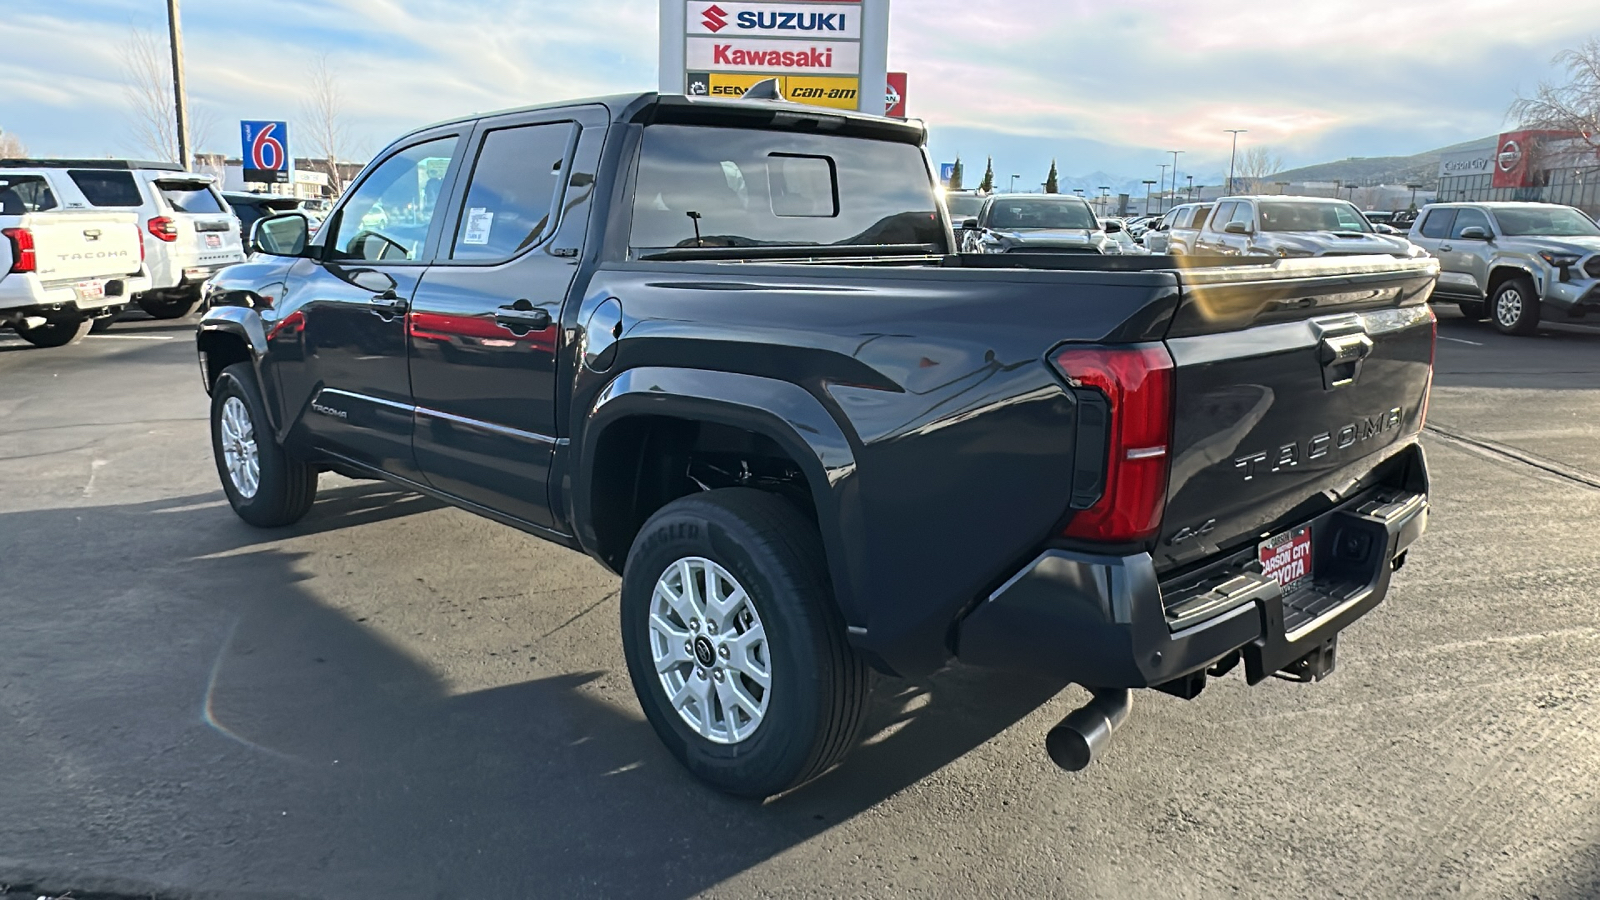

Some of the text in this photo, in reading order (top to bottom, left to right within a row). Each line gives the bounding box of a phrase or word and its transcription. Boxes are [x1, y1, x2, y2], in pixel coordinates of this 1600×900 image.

[737, 11, 846, 31] SUZUKI
[713, 44, 833, 68] Kawasaki
[791, 88, 857, 99] can-am
[252, 123, 284, 170] 6
[1444, 157, 1488, 171] Carson City
[57, 250, 128, 261] TACOMA
[312, 405, 347, 418] TACOMA
[1234, 406, 1404, 481] TACOMA
[1292, 540, 1311, 560] CITY
